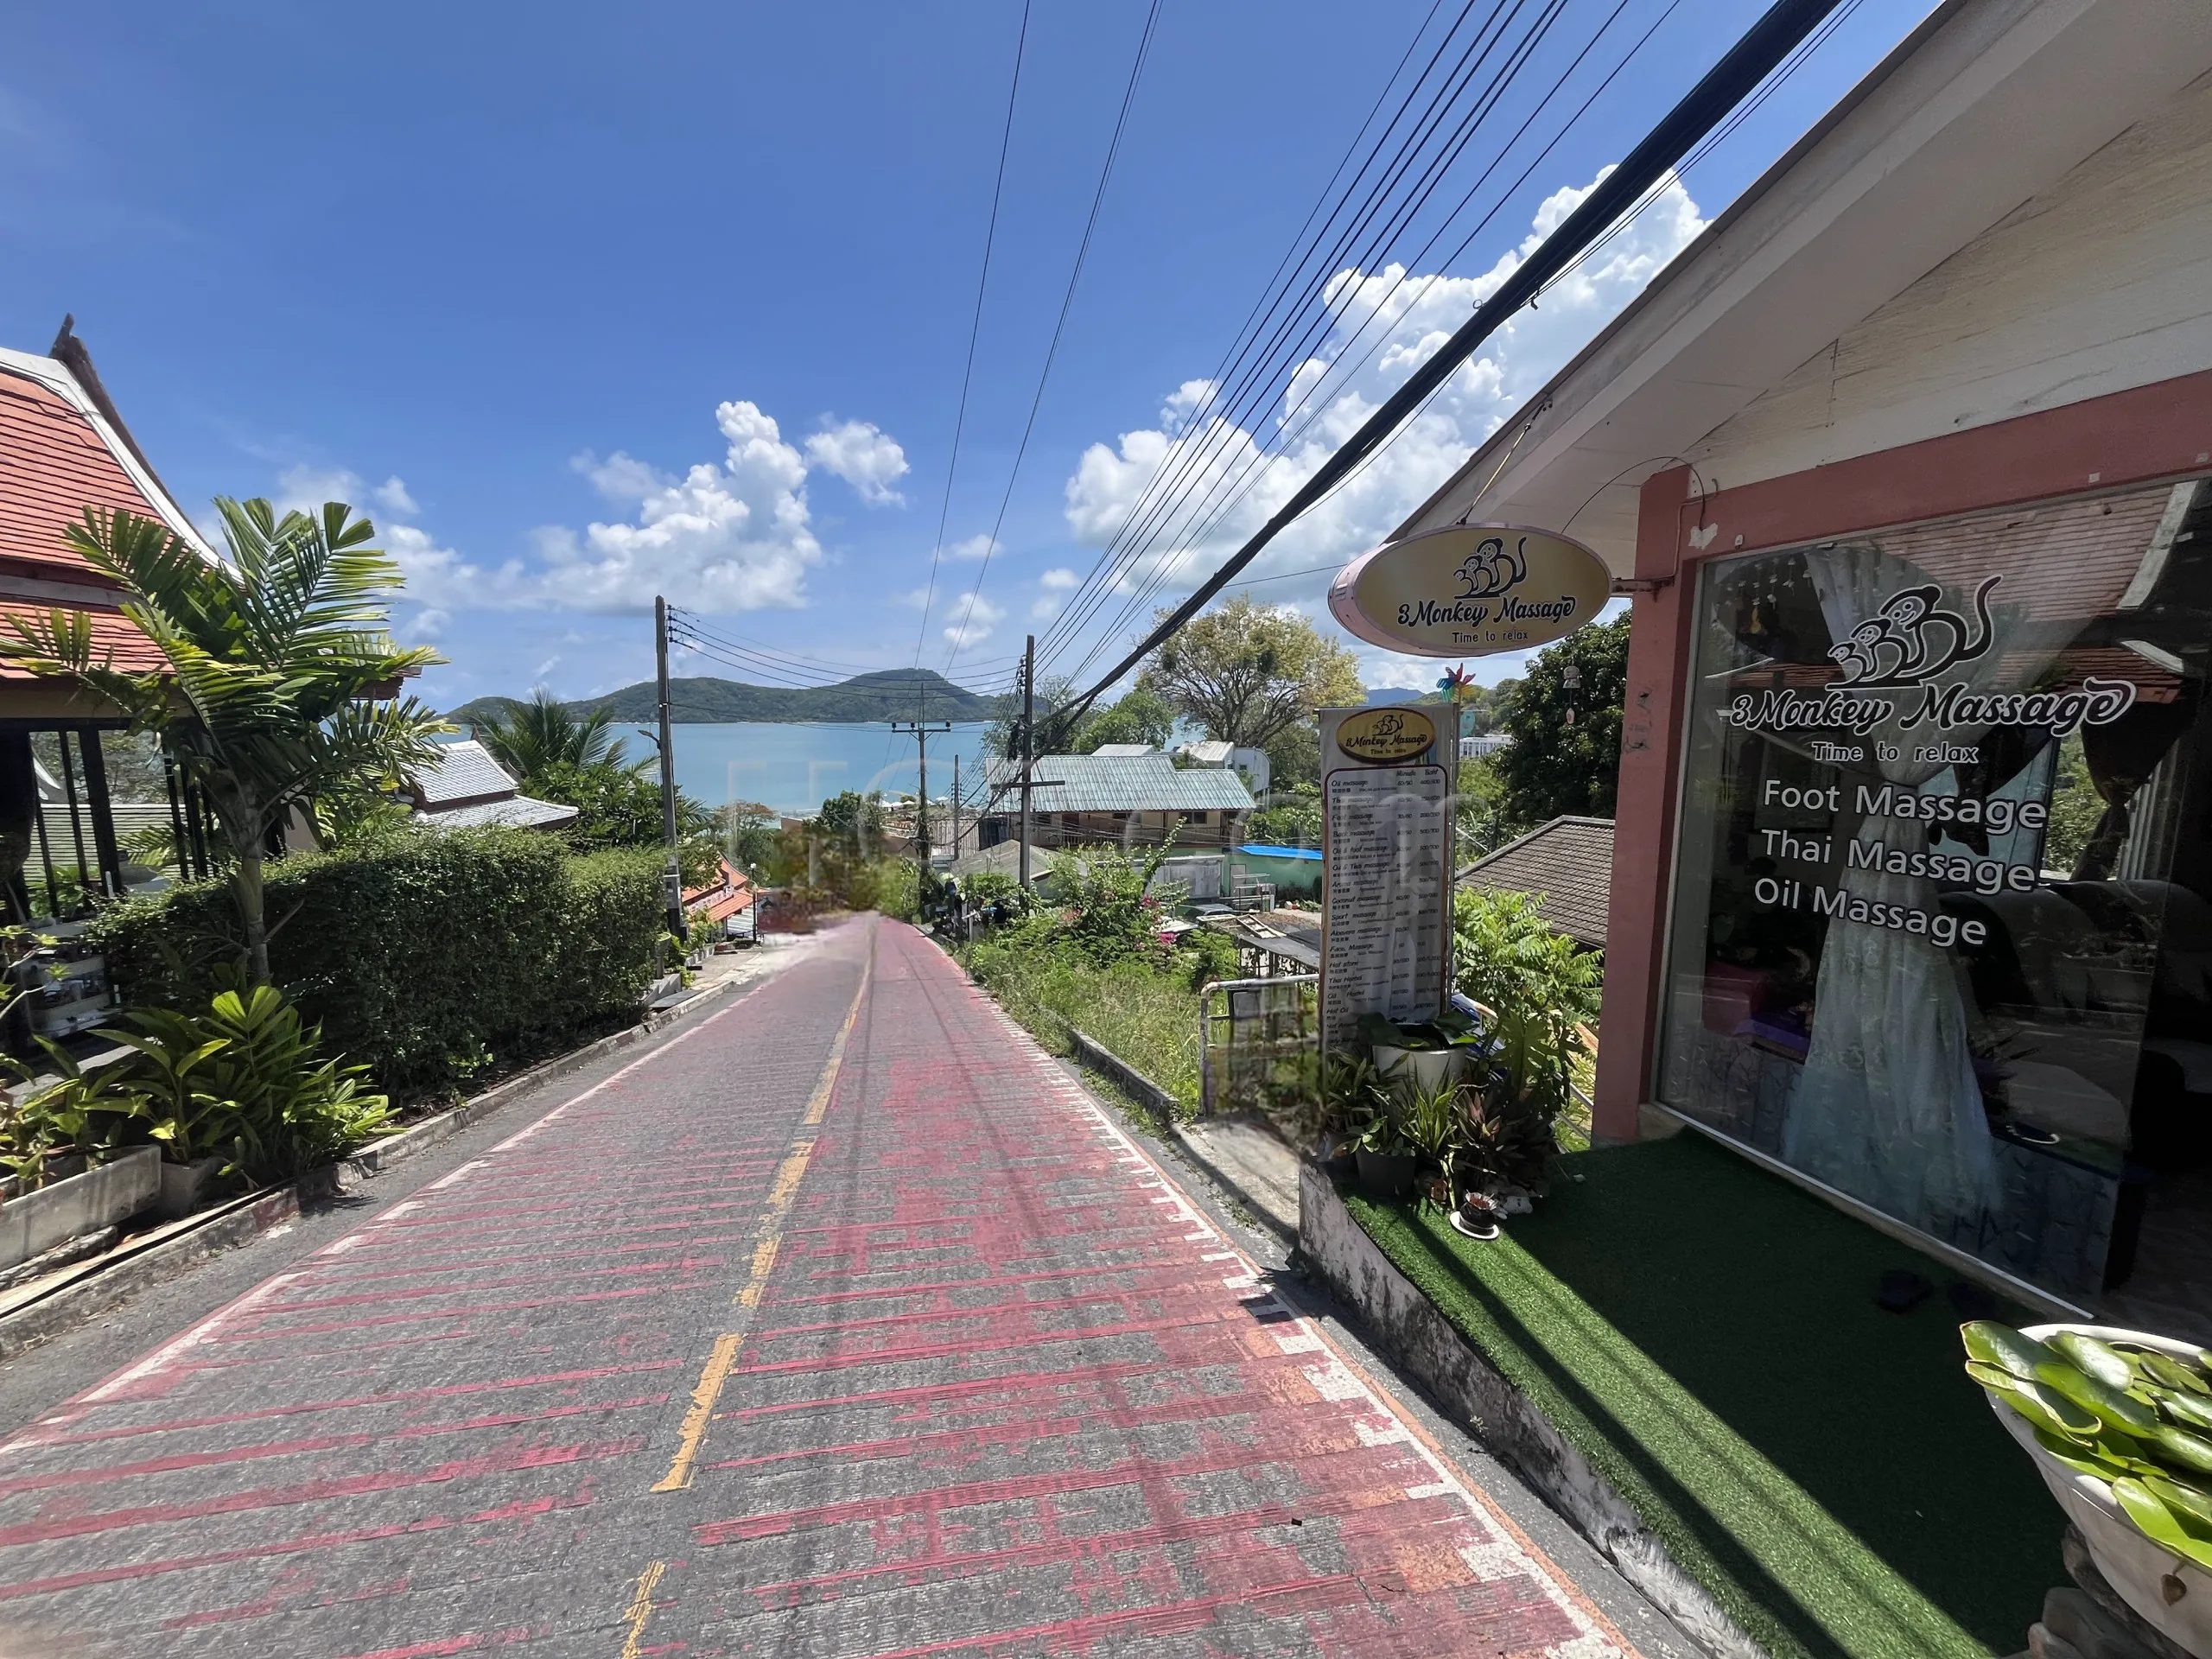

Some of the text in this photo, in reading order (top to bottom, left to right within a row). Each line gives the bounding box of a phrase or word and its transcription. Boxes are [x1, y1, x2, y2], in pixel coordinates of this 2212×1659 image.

[1452, 629, 1529, 644] Time to relax
[1493, 594, 1576, 625] Massage
[1898, 677, 2138, 738] Massage
[1811, 741, 1980, 765] Time to relax
[1762, 779, 2048, 836] Foot Massage
[1760, 828, 2037, 896] Thai Massage
[1753, 876, 1988, 948] Oil Massage
